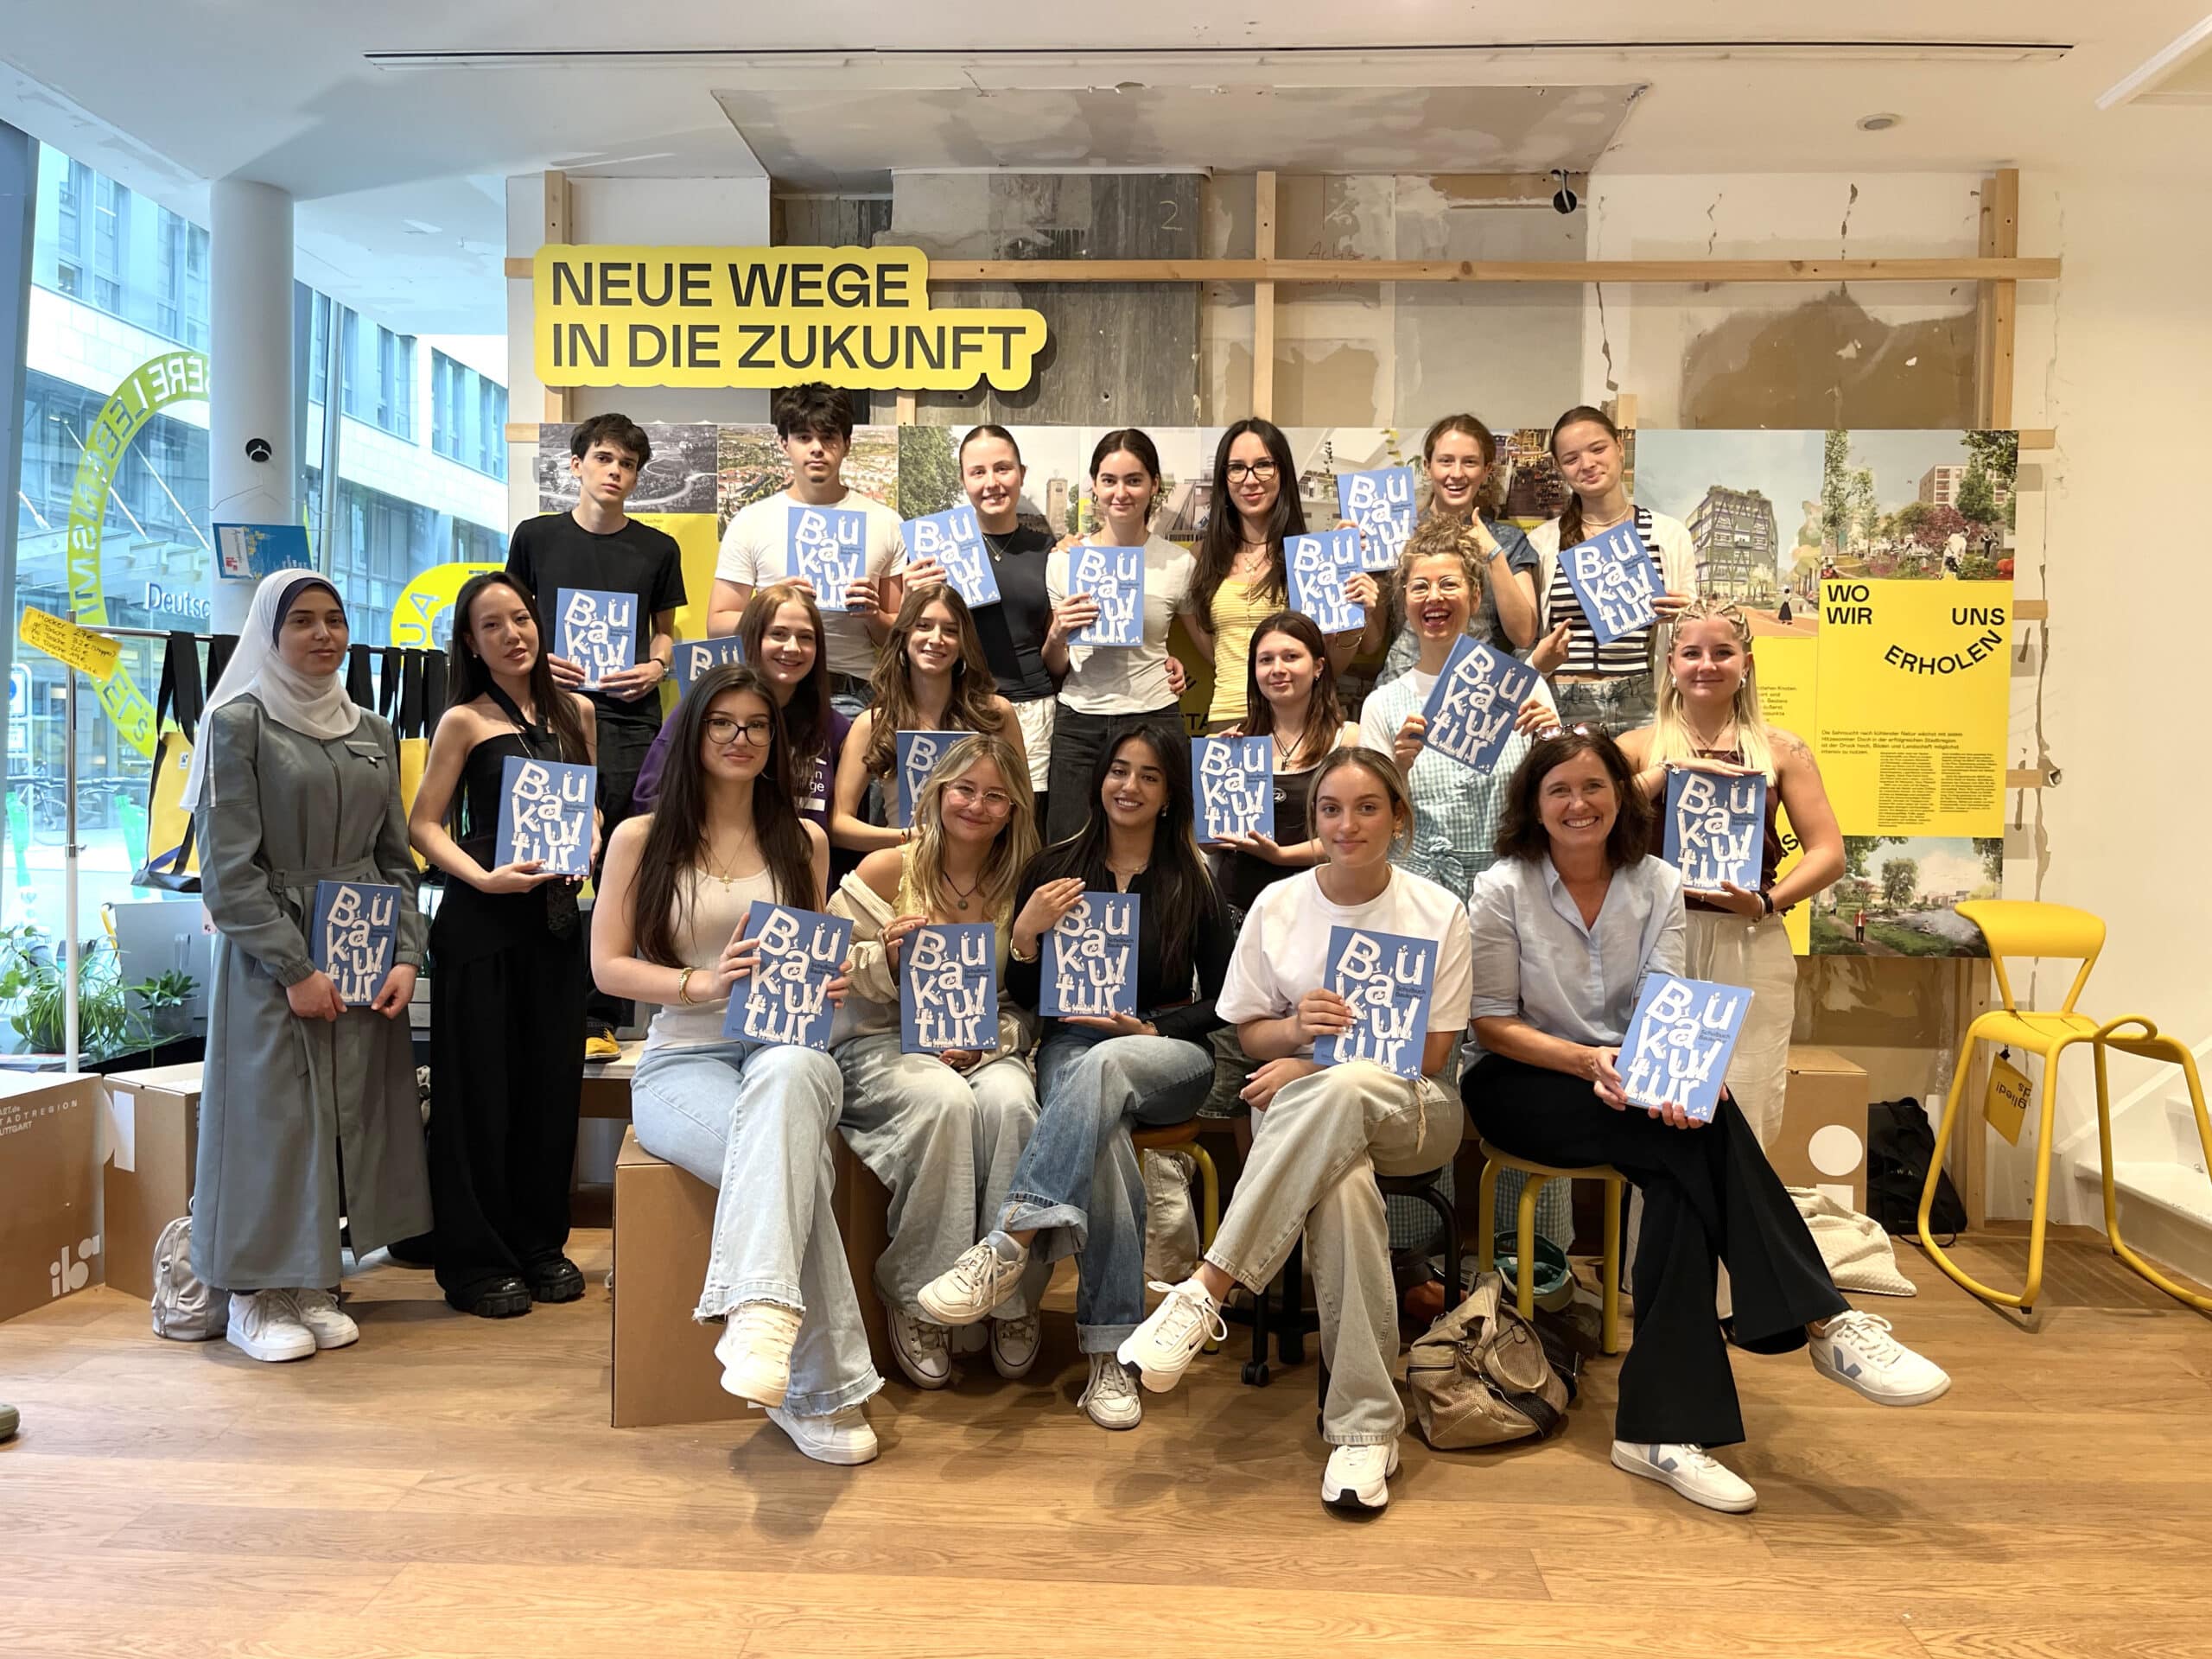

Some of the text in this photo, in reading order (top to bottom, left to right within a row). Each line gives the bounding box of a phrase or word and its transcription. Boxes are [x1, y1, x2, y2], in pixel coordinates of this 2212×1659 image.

[552, 262, 909, 308] NEUE WEGE
[553, 323, 1027, 371] IN DIE ZUKUNFT
[1826, 607, 2005, 626] WIR UNS
[1827, 585, 1870, 604] WO
[1884, 629, 2003, 676] ERHOLEN
